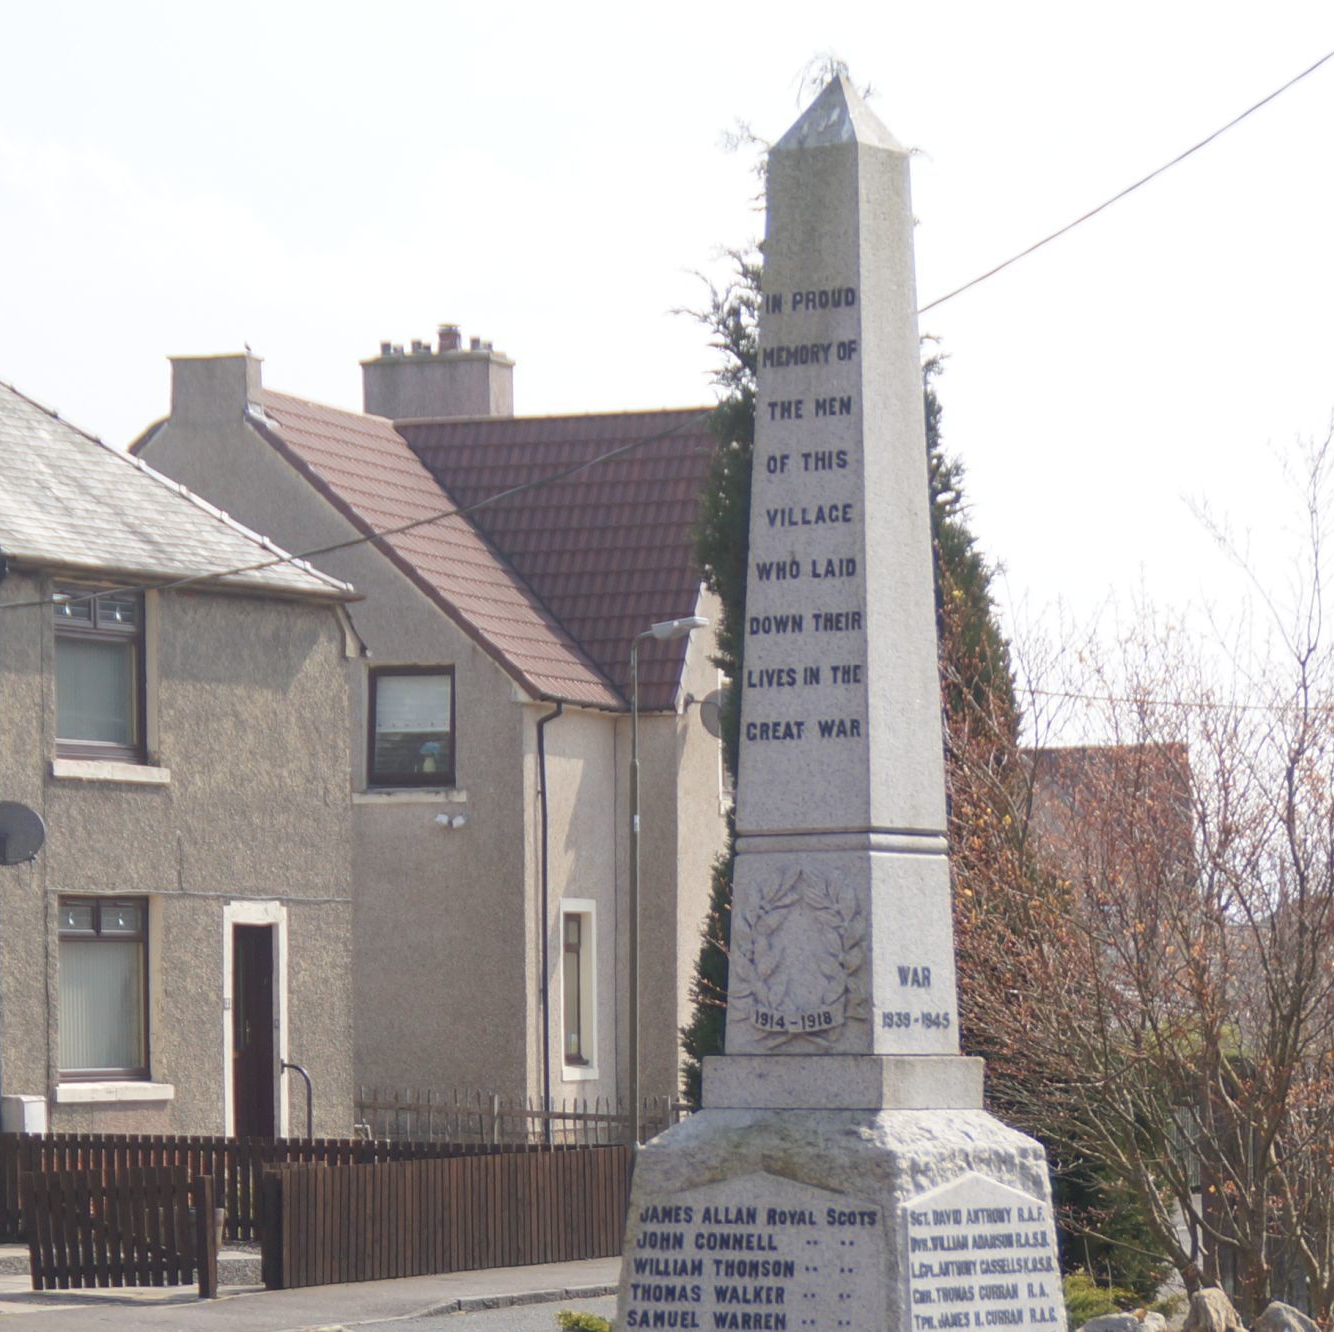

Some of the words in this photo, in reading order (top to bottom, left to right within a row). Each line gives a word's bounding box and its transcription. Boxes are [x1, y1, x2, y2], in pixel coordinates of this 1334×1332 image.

[765, 291, 783, 315] IN
[792, 287, 856, 311] PROUD
[762, 343, 832, 368] MEMORY
[836, 339, 858, 361] OF
[768, 400, 803, 421] THE
[815, 396, 852, 417] MEN
[767, 454, 790, 474] OF
[801, 450, 848, 471] THIS
[766, 504, 853, 528] VILLAGE
[756, 559, 801, 582] WHO
[811, 557, 857, 579] LAID
[749, 614, 803, 635] DOWN
[812, 611, 862, 632] THEIR
[747, 668, 797, 689] LIVES
[803, 666, 820, 686] IN
[830, 664, 862, 684] THE
[746, 721, 804, 742] GREAT
[818, 718, 861, 738] WAR
[897, 965, 931, 988] WAR
[639, 1206, 694, 1225] JAMES
[701, 1206, 758, 1225] ALLAN
[767, 1207, 816, 1226] ROYAL
[826, 1208, 878, 1227] SCOTS
[932, 1208, 962, 1226] DAVID
[966, 1206, 1012, 1225] ANTHONY
[636, 1231, 684, 1250] JOHN
[694, 1231, 778, 1252] CONNELL
[930, 1234, 969, 1251] WILLIAM
[633, 1257, 703, 1277] WILLIAM
[713, 1259, 795, 1279] THOMSON
[630, 1283, 702, 1303] THOMAS
[714, 1285, 786, 1305] WALKER
[935, 1286, 975, 1303] THOMAS
[978, 1283, 1019, 1301] CURRAN
[626, 1310, 700, 1329] SAMUEL
[713, 1311, 787, 1331] WARREN
[937, 1311, 971, 1329] JAMES
[985, 1307, 1024, 1326] CURRAN
